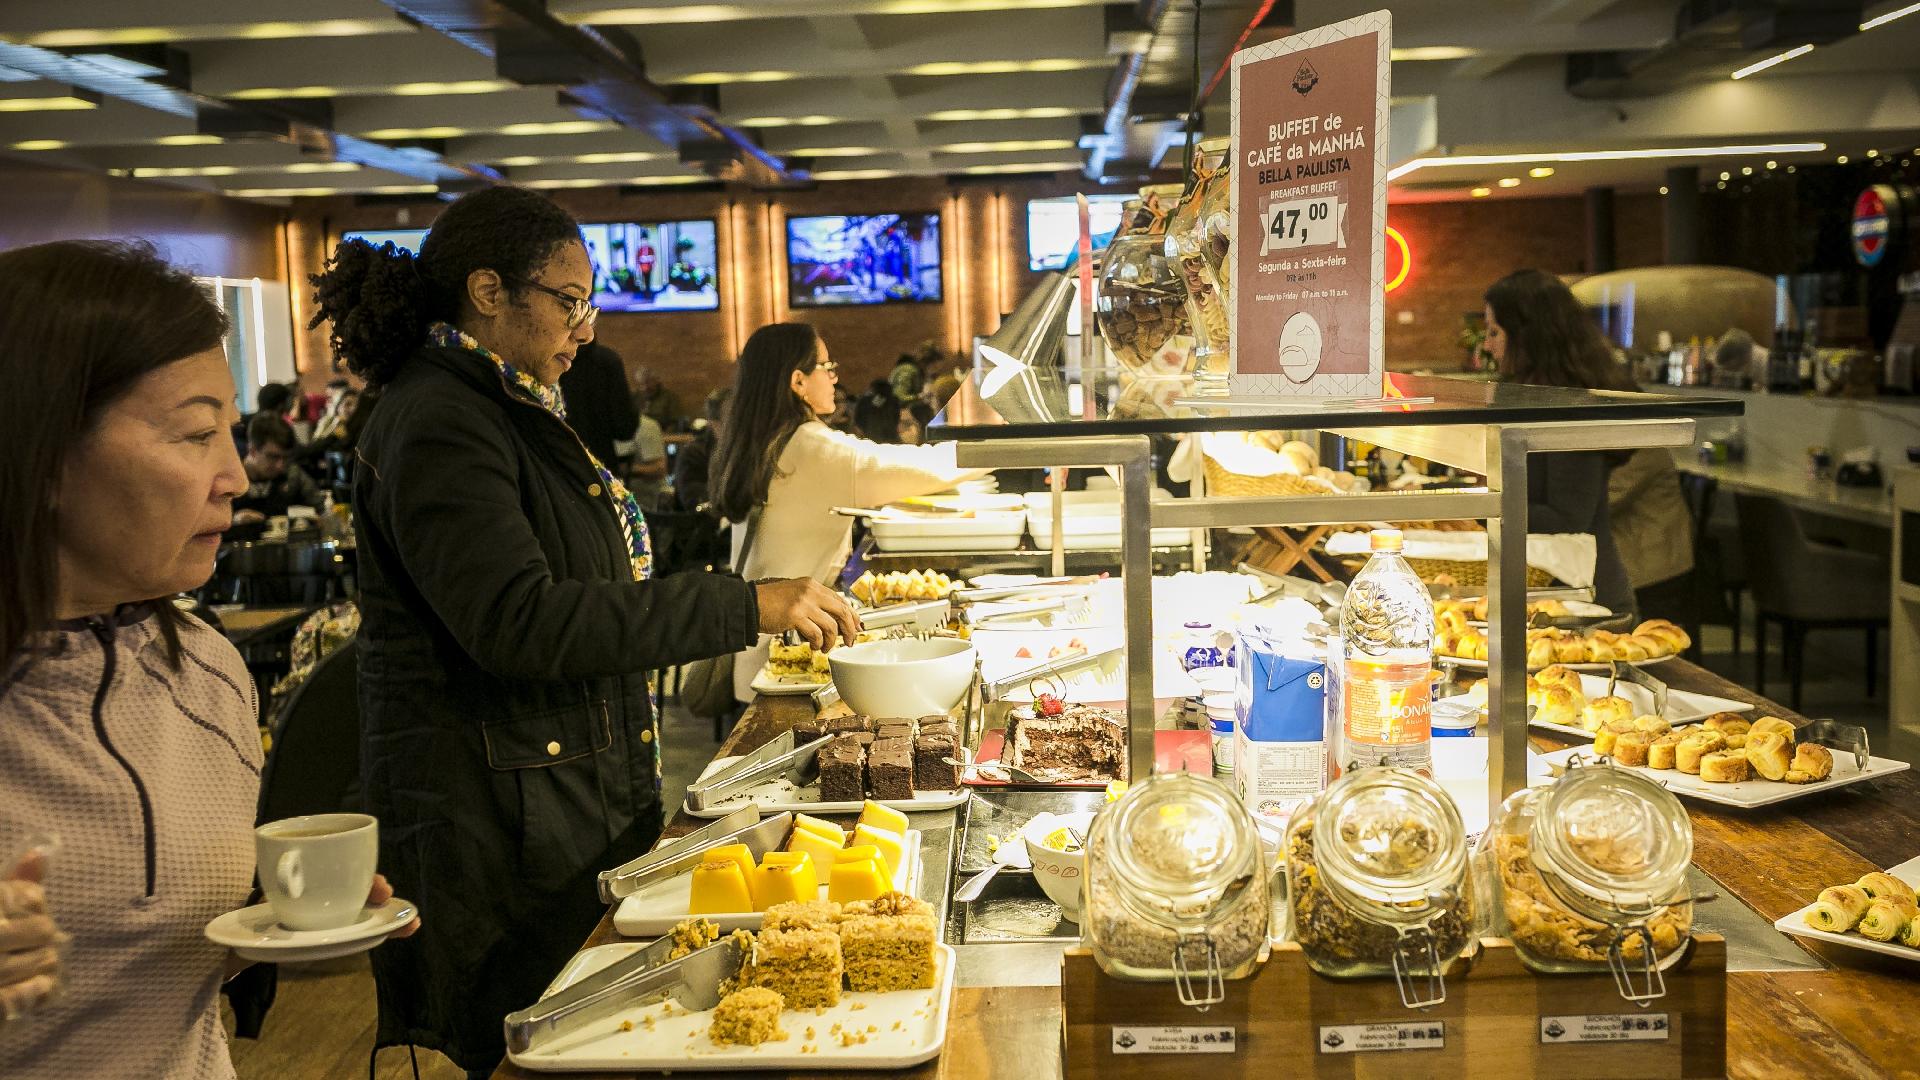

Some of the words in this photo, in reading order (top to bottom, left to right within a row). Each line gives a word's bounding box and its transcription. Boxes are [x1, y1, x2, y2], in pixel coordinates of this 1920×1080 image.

[1268, 116, 1319, 142] BUFFET
[1323, 113, 1342, 131] de
[1247, 142, 1282, 167] CAFÉ
[1286, 143, 1303, 160] da
[1309, 125, 1365, 157] MANHÃ
[1259, 168, 1292, 185] BELLA
[1296, 157, 1351, 179] PAULISTA
[1270, 185, 1309, 199] BREAKFAST
[1310, 181, 1338, 194] BUFFET
[1258, 260, 1291, 274] Segunda
[1302, 255, 1346, 269] Sexta-feira
[1283, 292, 1298, 301] Friday
